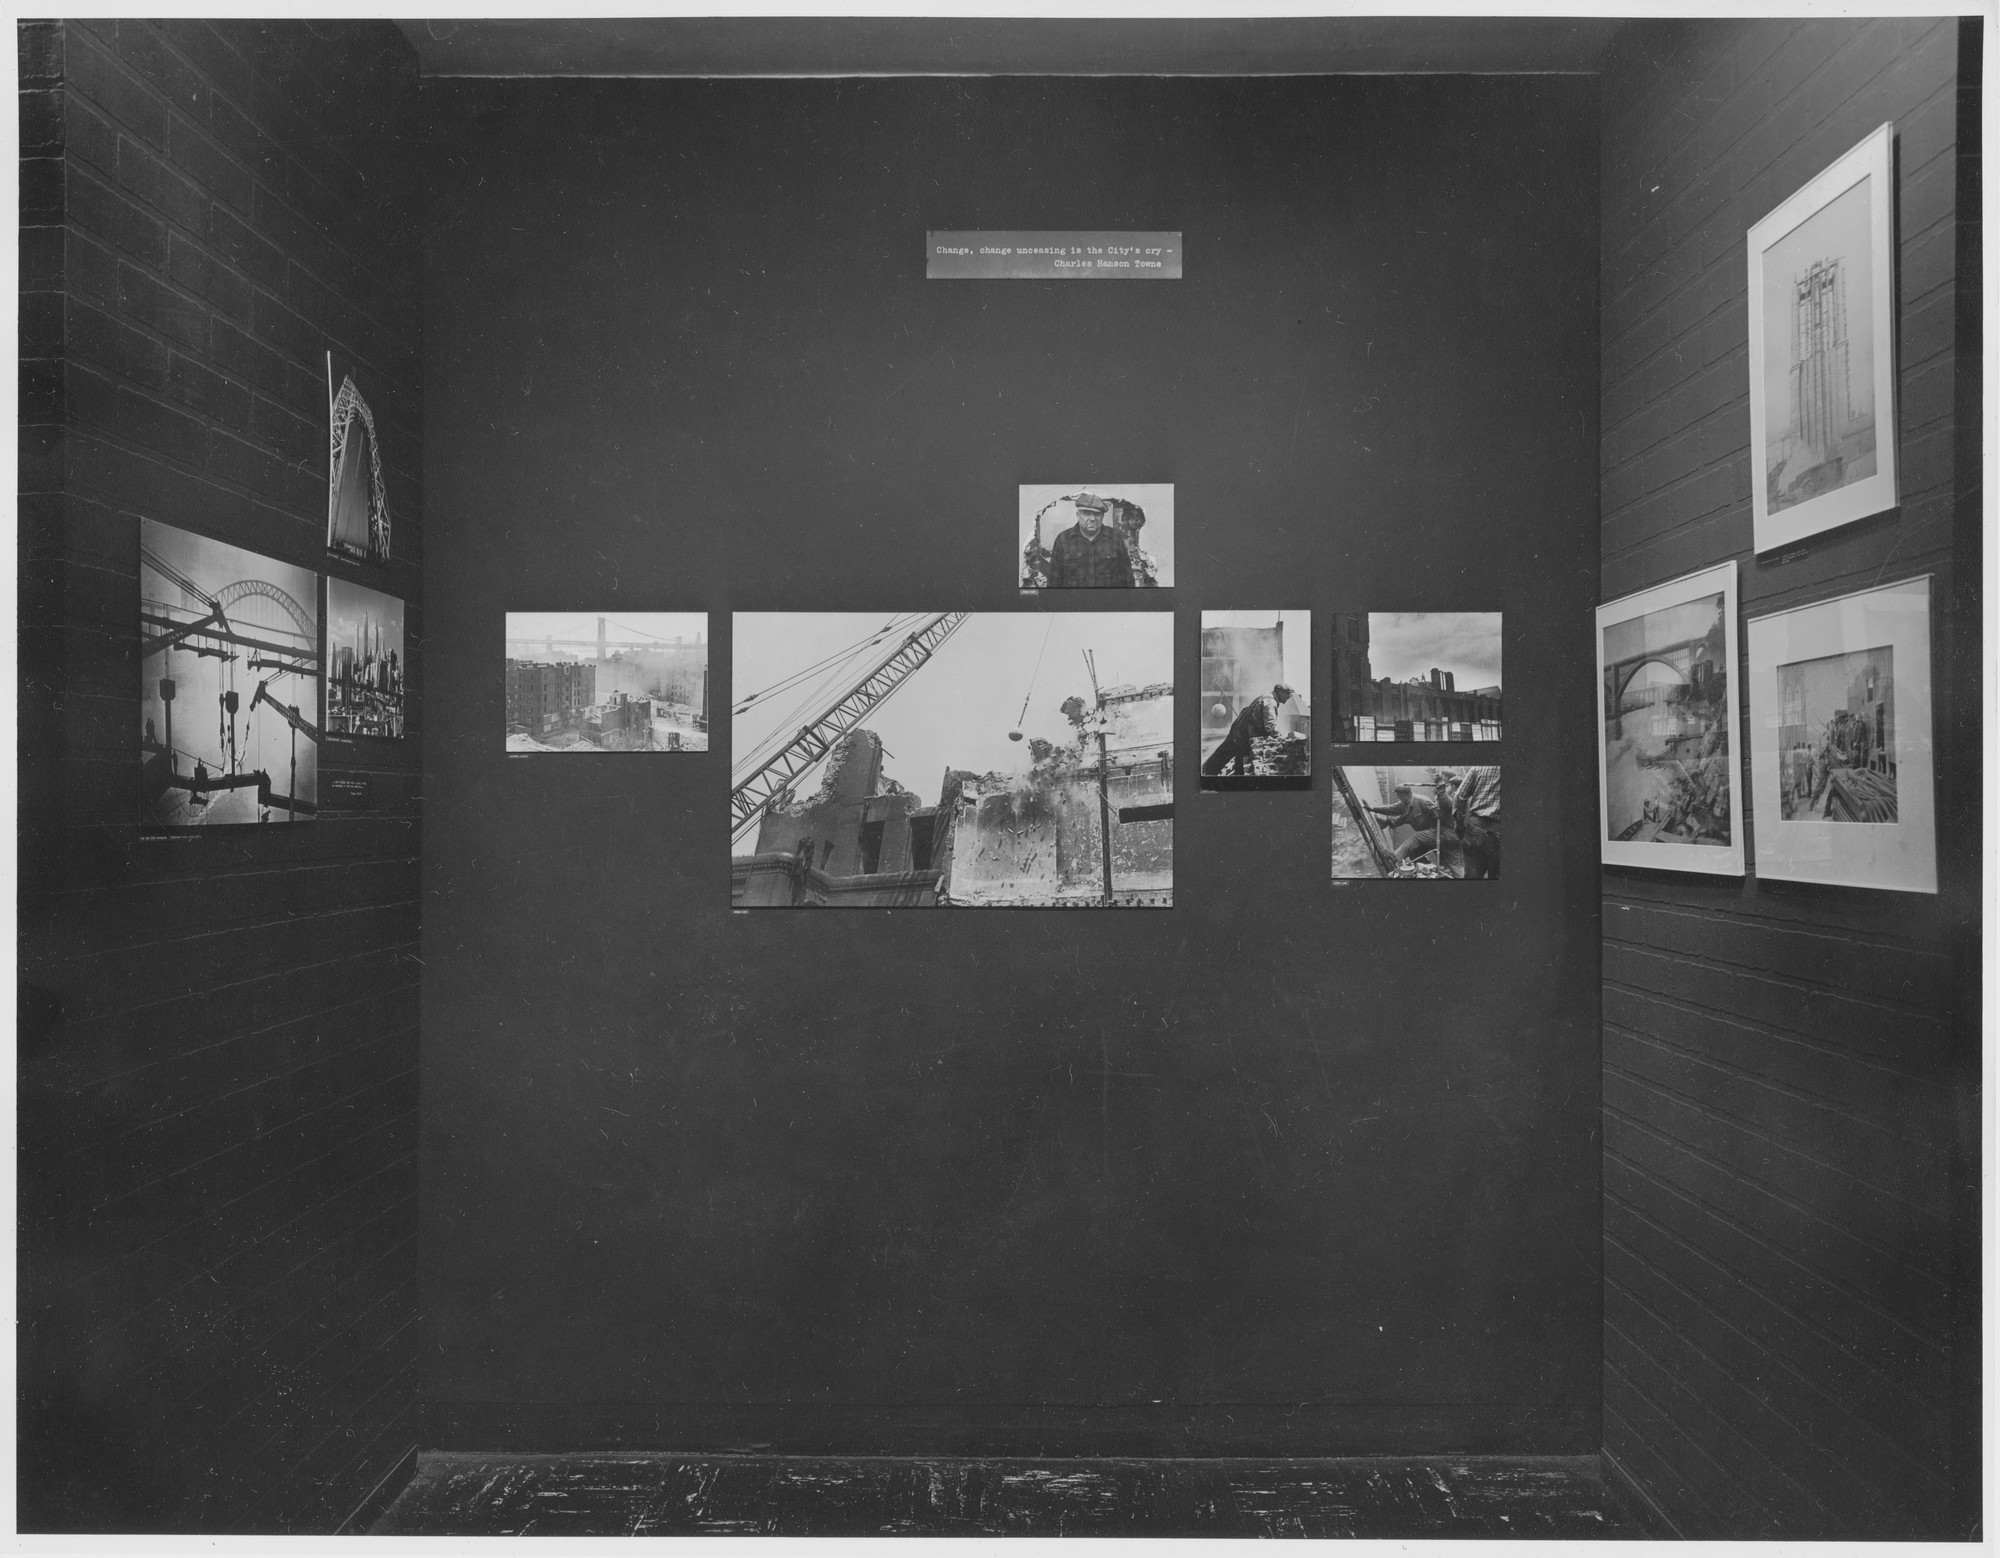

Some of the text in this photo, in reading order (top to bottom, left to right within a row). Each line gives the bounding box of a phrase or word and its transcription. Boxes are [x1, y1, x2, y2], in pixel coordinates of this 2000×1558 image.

[936, 246, 974, 255] Change,
[980, 246, 1012, 255] change
[1016, 246, 1066, 256] unceasing
[1070, 246, 1082, 254] is
[1086, 246, 1103, 254] the
[1107, 246, 1140, 256] City's
[1145, 247, 1162, 256] cry
[1054, 259, 1162, 268] Charles Hanson Towne
